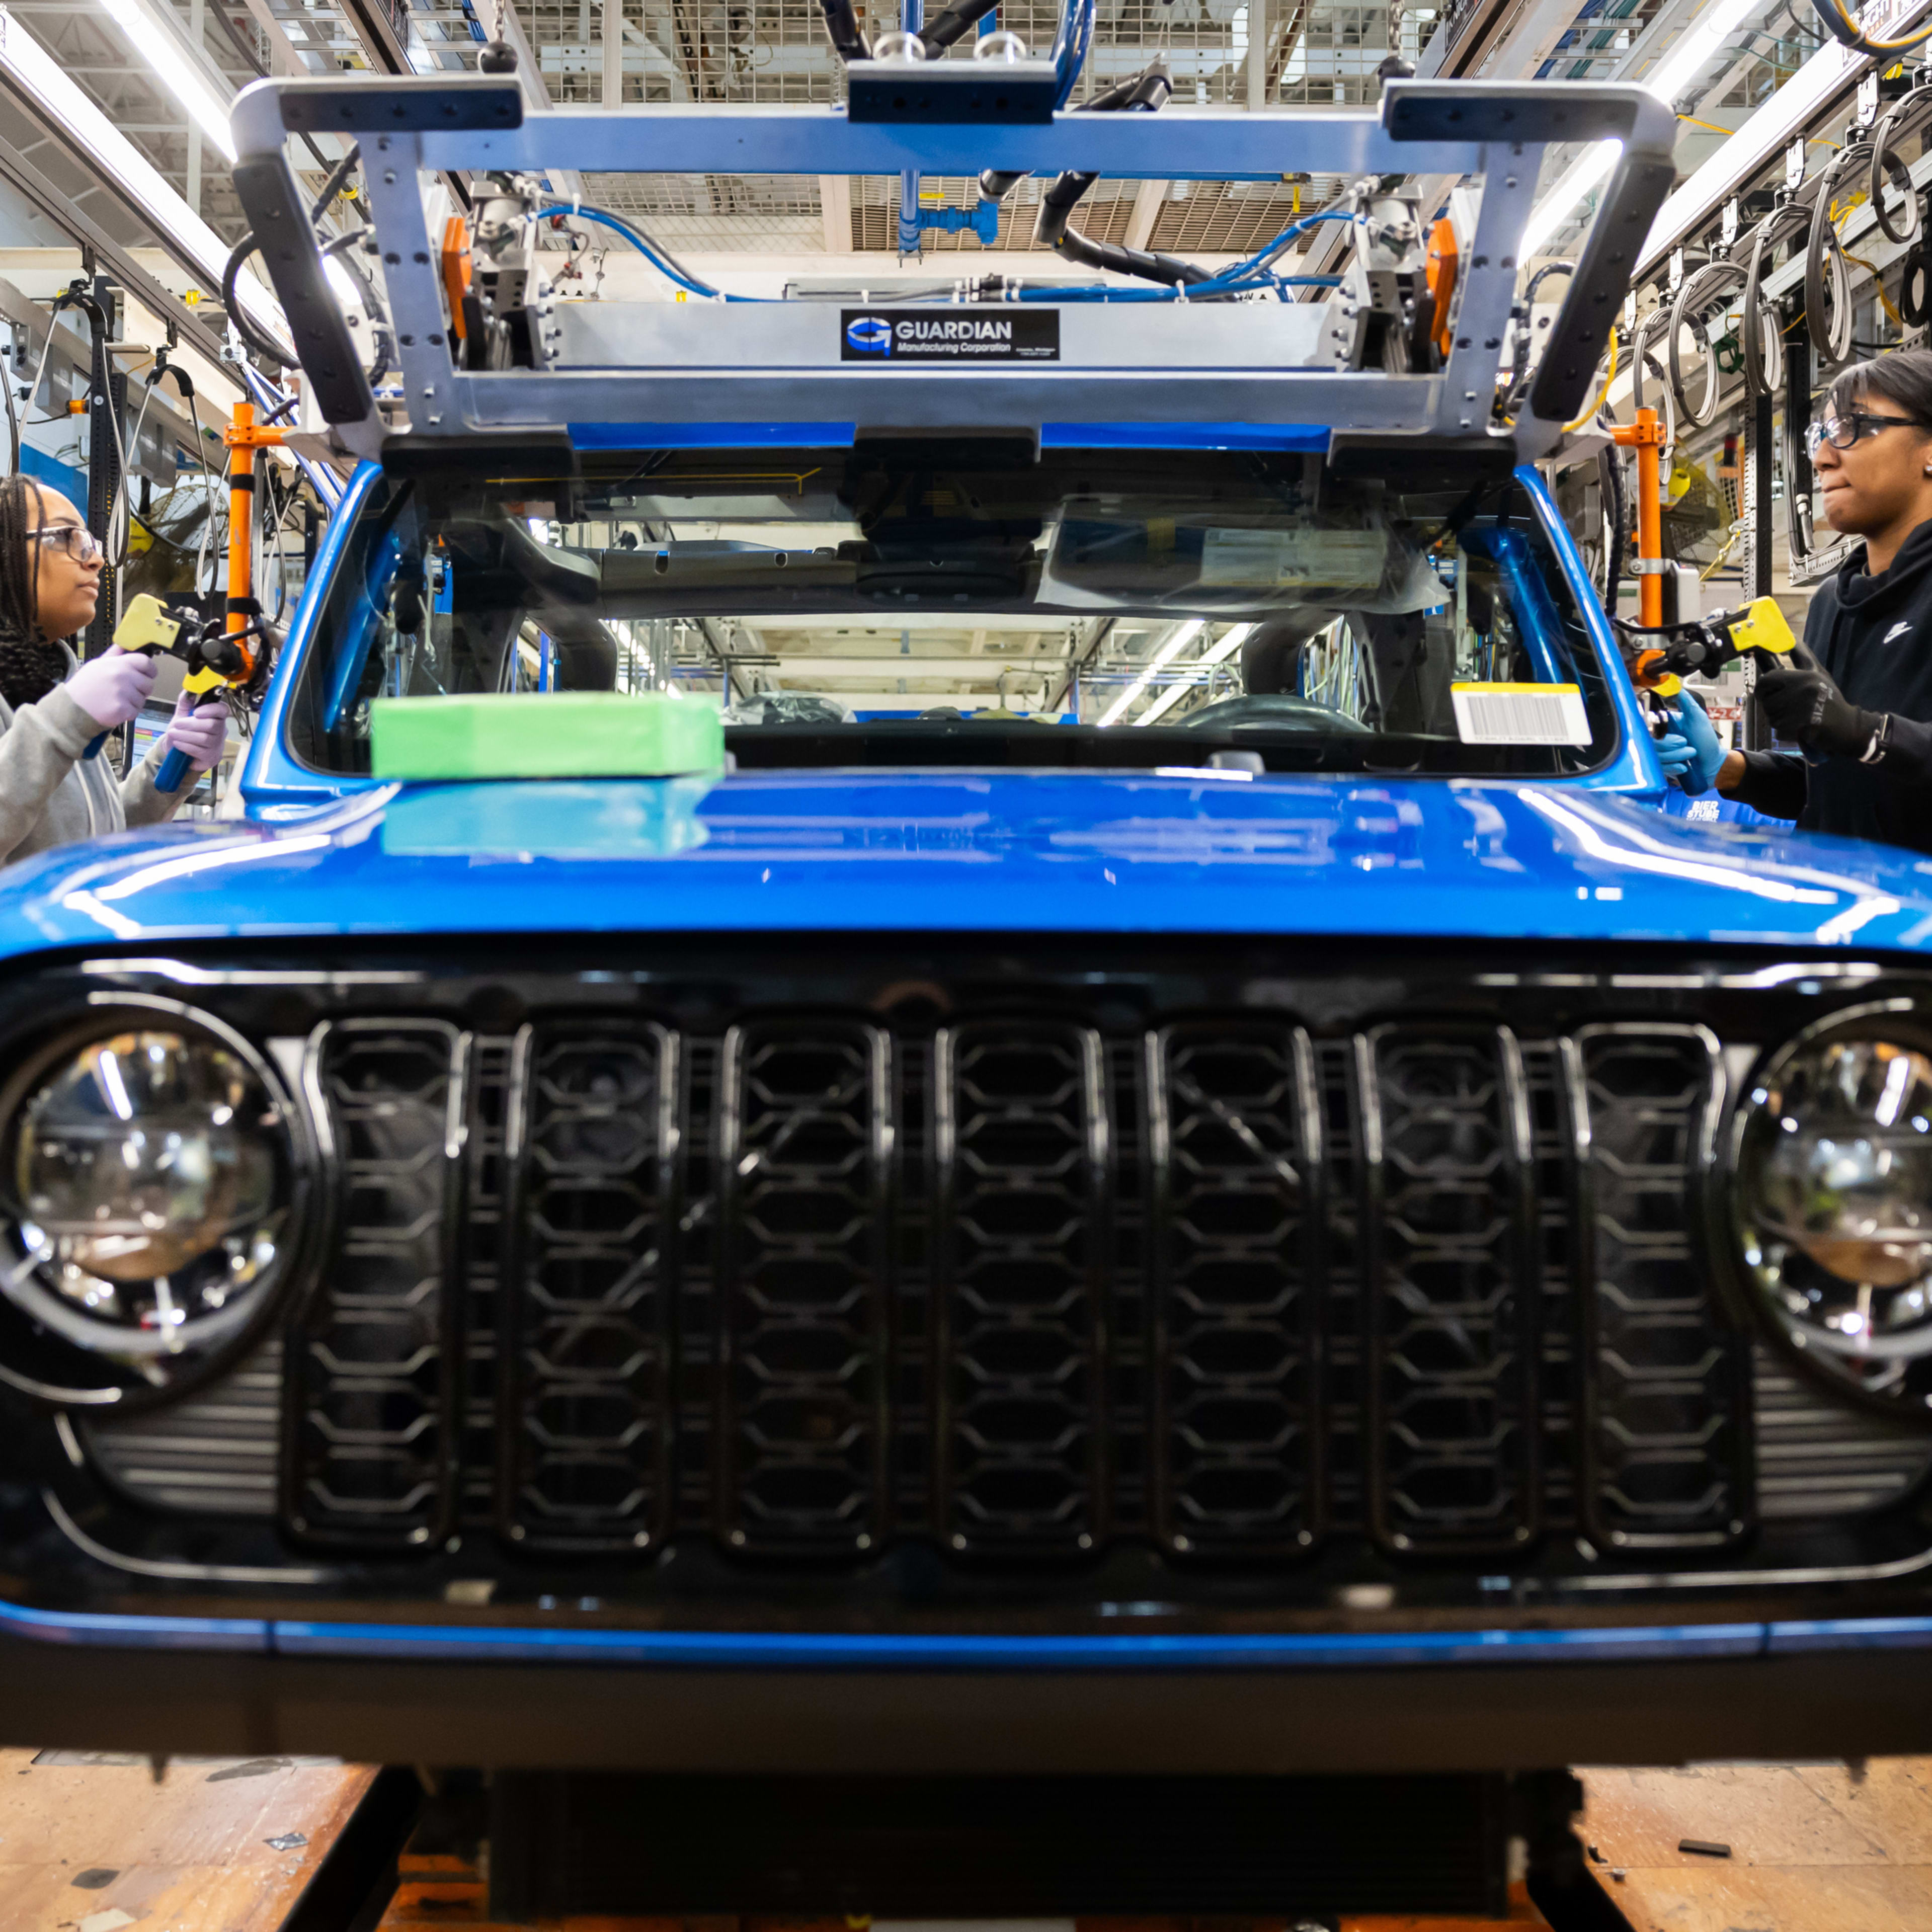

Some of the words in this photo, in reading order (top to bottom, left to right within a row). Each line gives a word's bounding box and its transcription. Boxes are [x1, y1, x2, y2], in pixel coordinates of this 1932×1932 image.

[896, 321, 1012, 340] GUARDIAN
[897, 342, 959, 354] Manufacturing
[960, 342, 1011, 353] Corporation
[1692, 800, 1719, 811] BIER
[1686, 810, 1720, 819] STUBE
